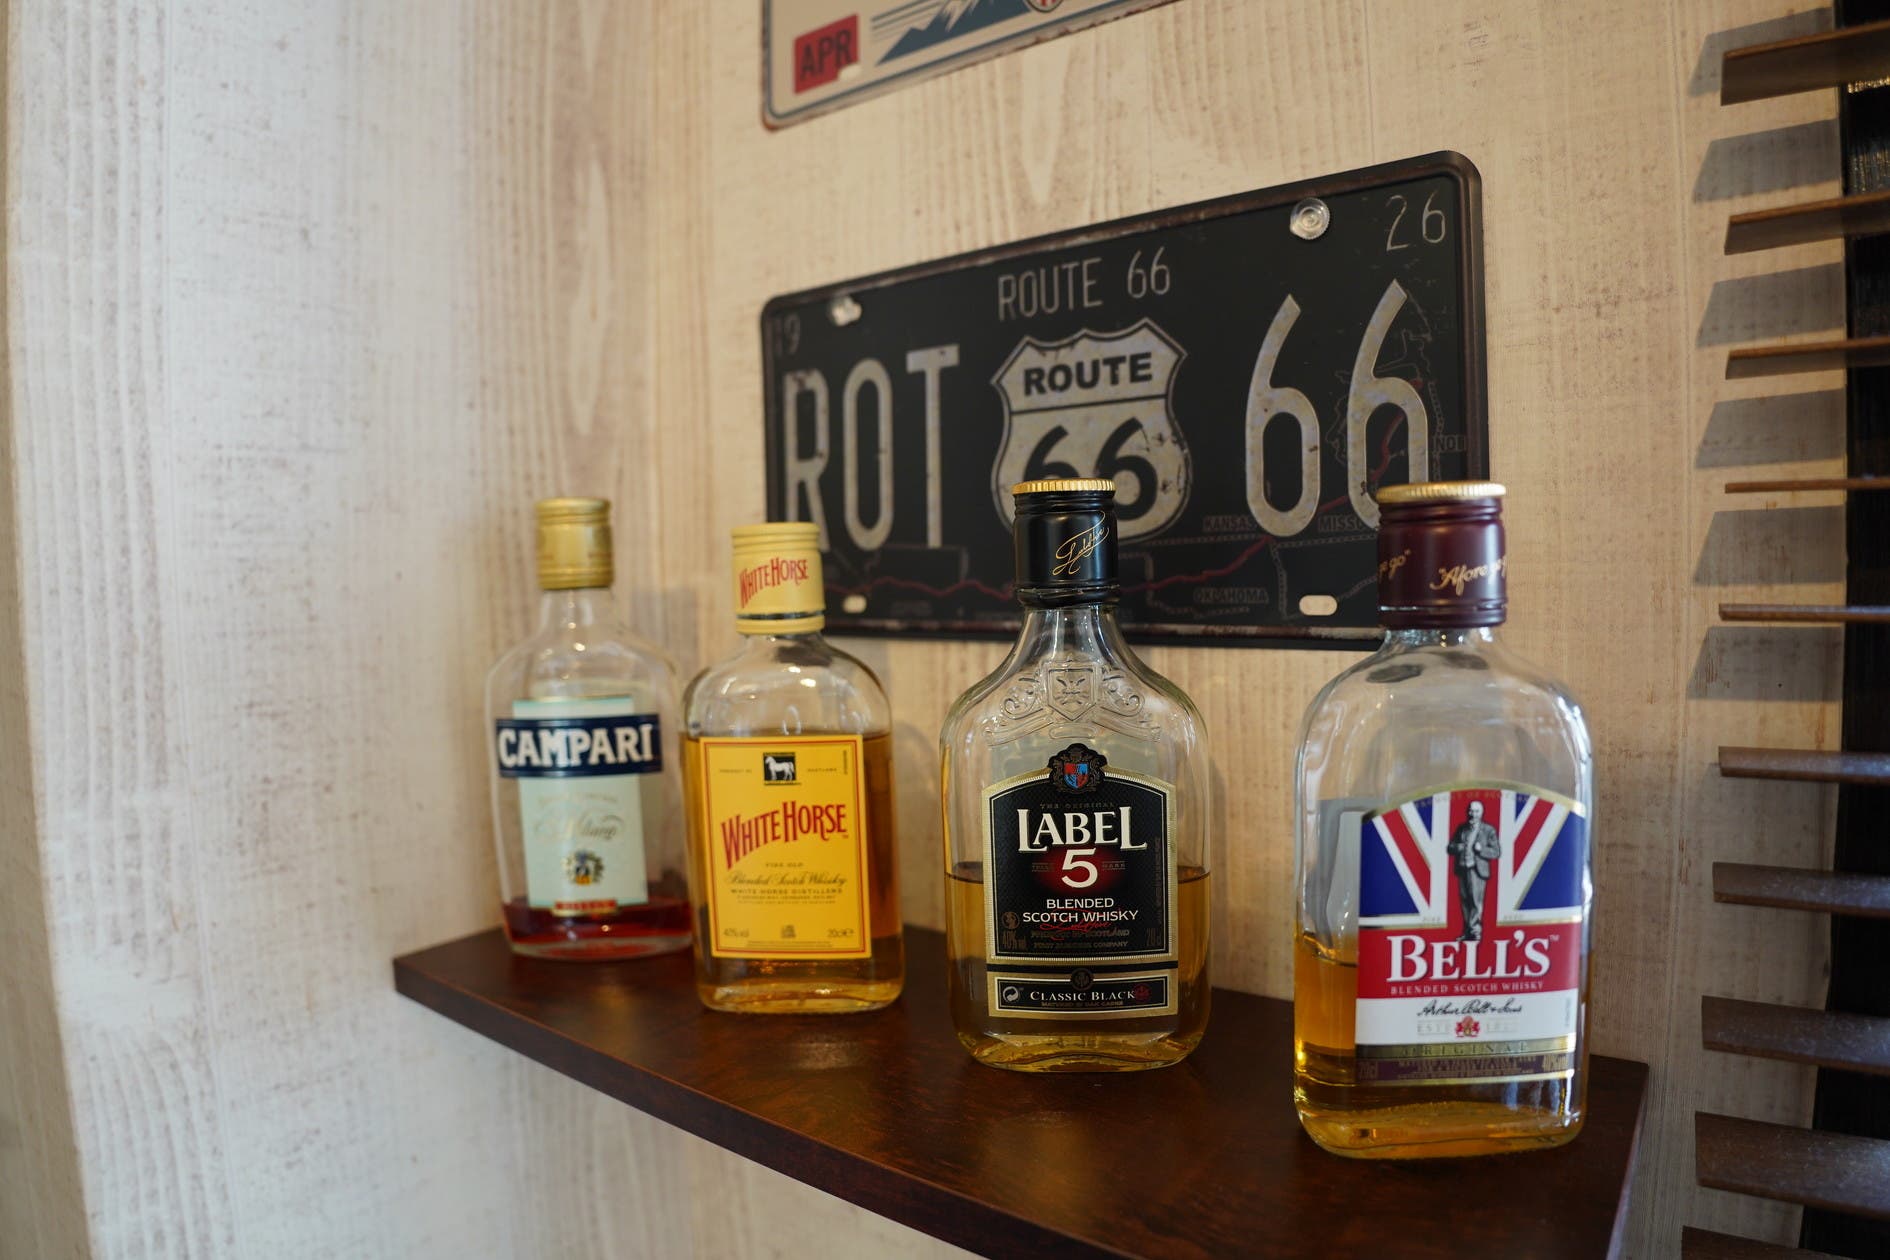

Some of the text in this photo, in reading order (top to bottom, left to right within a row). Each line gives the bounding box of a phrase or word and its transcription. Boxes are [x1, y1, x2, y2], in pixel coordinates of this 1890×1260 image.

[800, 29, 853, 80] APR
[1386, 189, 1446, 251] 26
[998, 246, 1171, 321] ROUTE 66
[1023, 352, 1153, 396] ROUTE
[784, 278, 1429, 552] ROT 66
[499, 723, 654, 768] CAMPARI
[1017, 806, 1148, 852] LABEL
[1061, 847, 1098, 889] 5
[1022, 910, 1139, 923] SCOTCH WHISKY
[1046, 898, 1114, 909] BLENDED
[1386, 930, 1551, 983] BELL'S
[1030, 990, 1136, 1001] CLASSIC BLACK
[1390, 981, 1544, 995] BLENDED SCOTCH WHISKY
